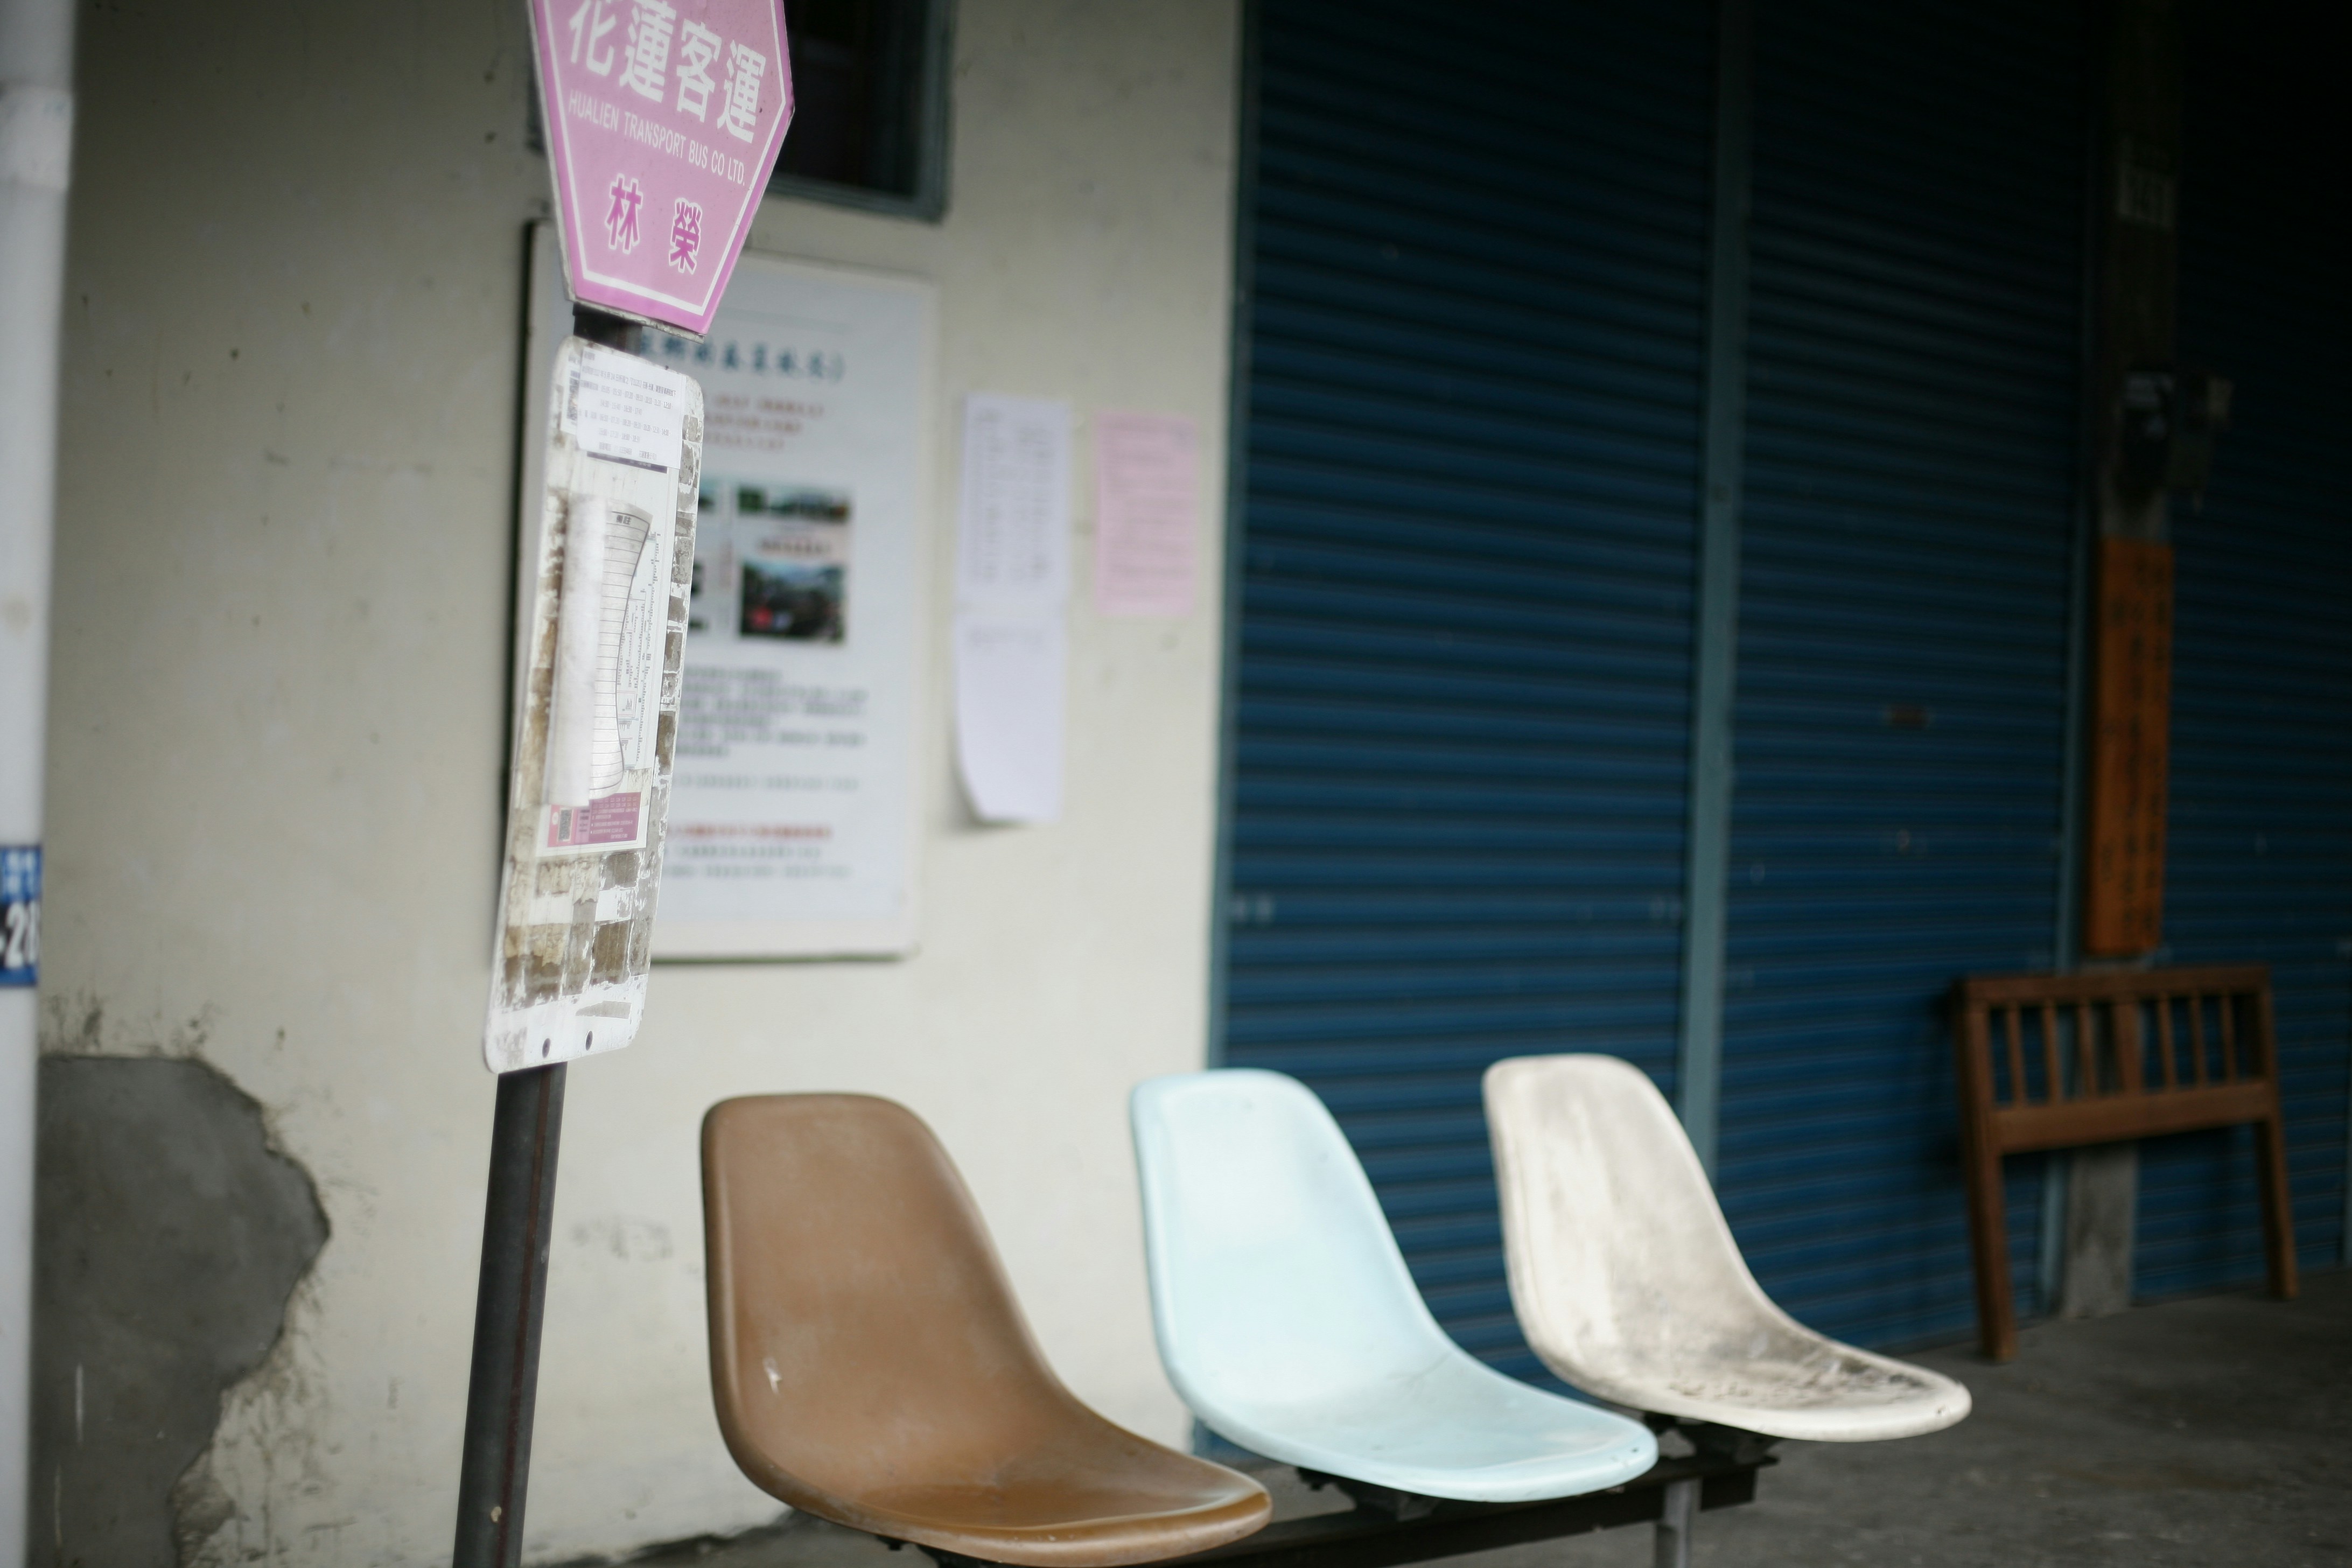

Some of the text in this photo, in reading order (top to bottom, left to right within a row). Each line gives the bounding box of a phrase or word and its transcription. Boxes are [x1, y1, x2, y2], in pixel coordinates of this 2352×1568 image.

[568, 90, 745, 186] HUALIEN TRANSPORT BUS CO LTD.
